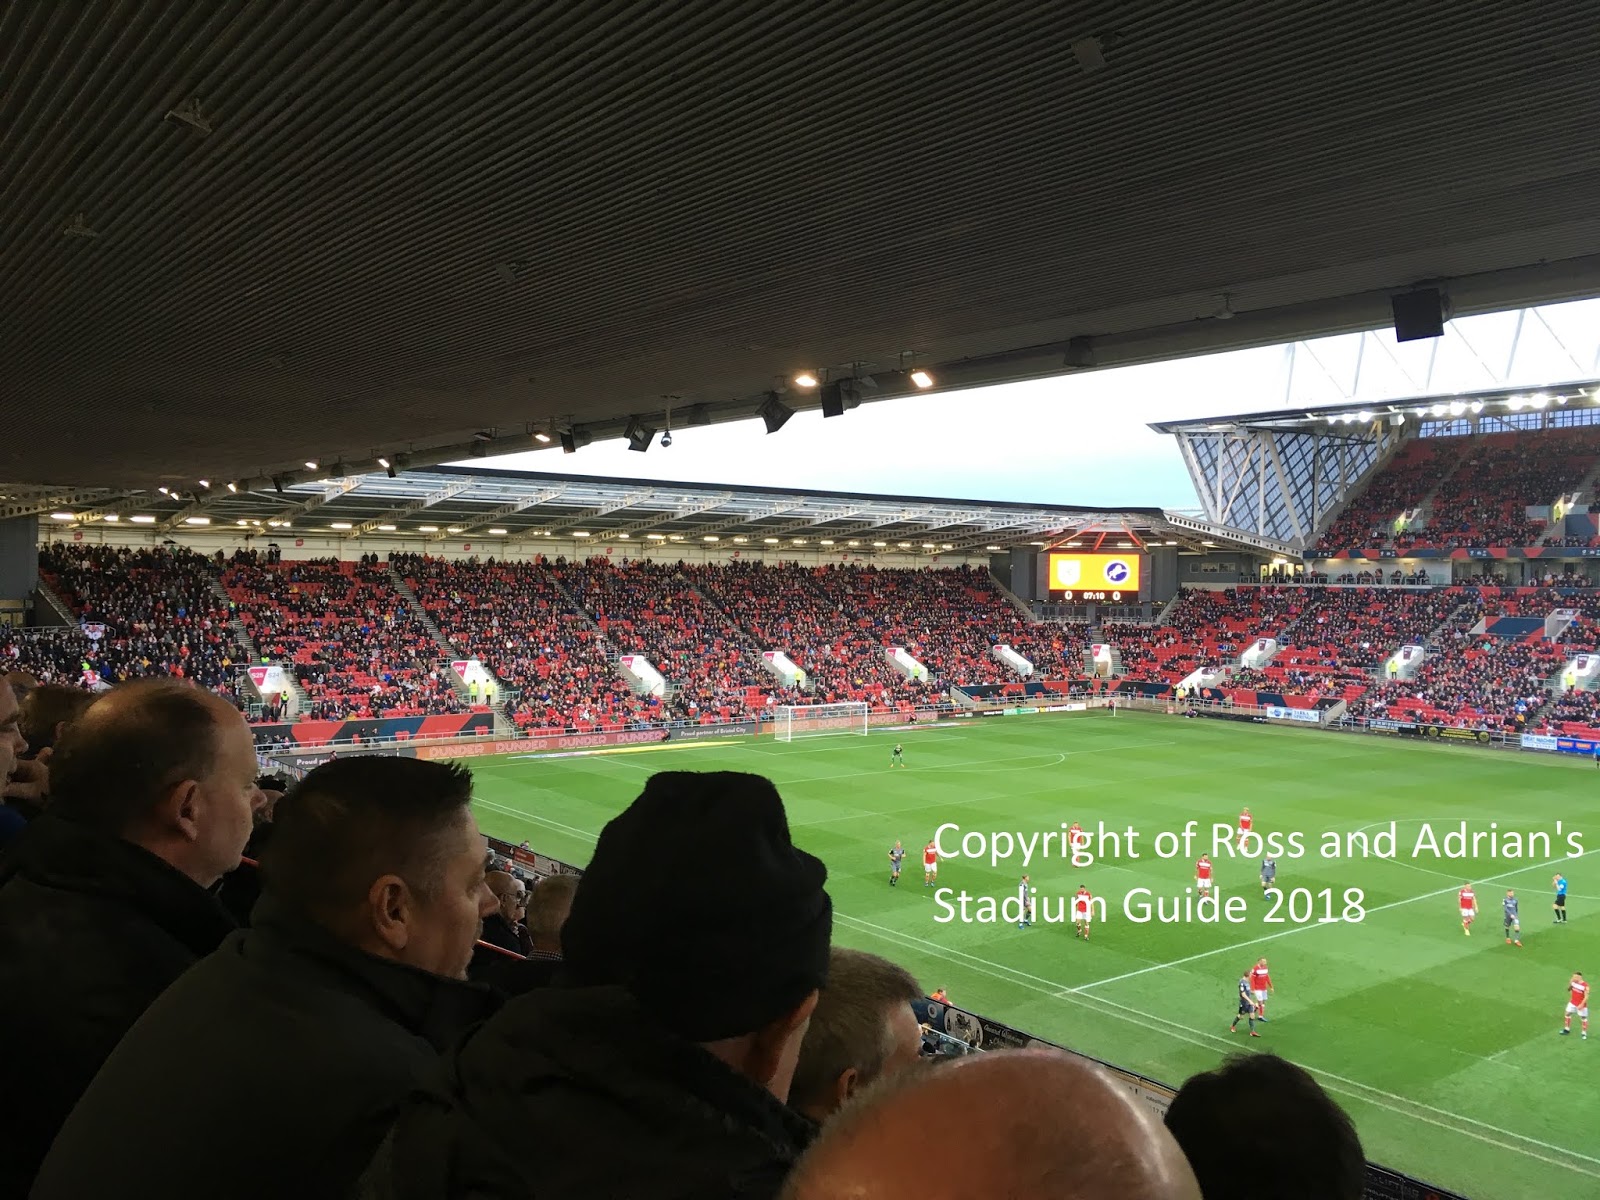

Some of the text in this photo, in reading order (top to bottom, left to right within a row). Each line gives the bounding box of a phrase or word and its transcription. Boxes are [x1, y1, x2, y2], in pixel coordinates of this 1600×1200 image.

[1065, 590, 1073, 600] 0
[1112, 591, 1121, 601] 0
[617, 730, 661, 743] DUNDER
[736, 726, 746, 734] City
[495, 739, 548, 752] DUNDER
[559, 735, 607, 748] DUNDER
[429, 744, 485, 757] DUNDER
[296, 757, 318, 766] Proud
